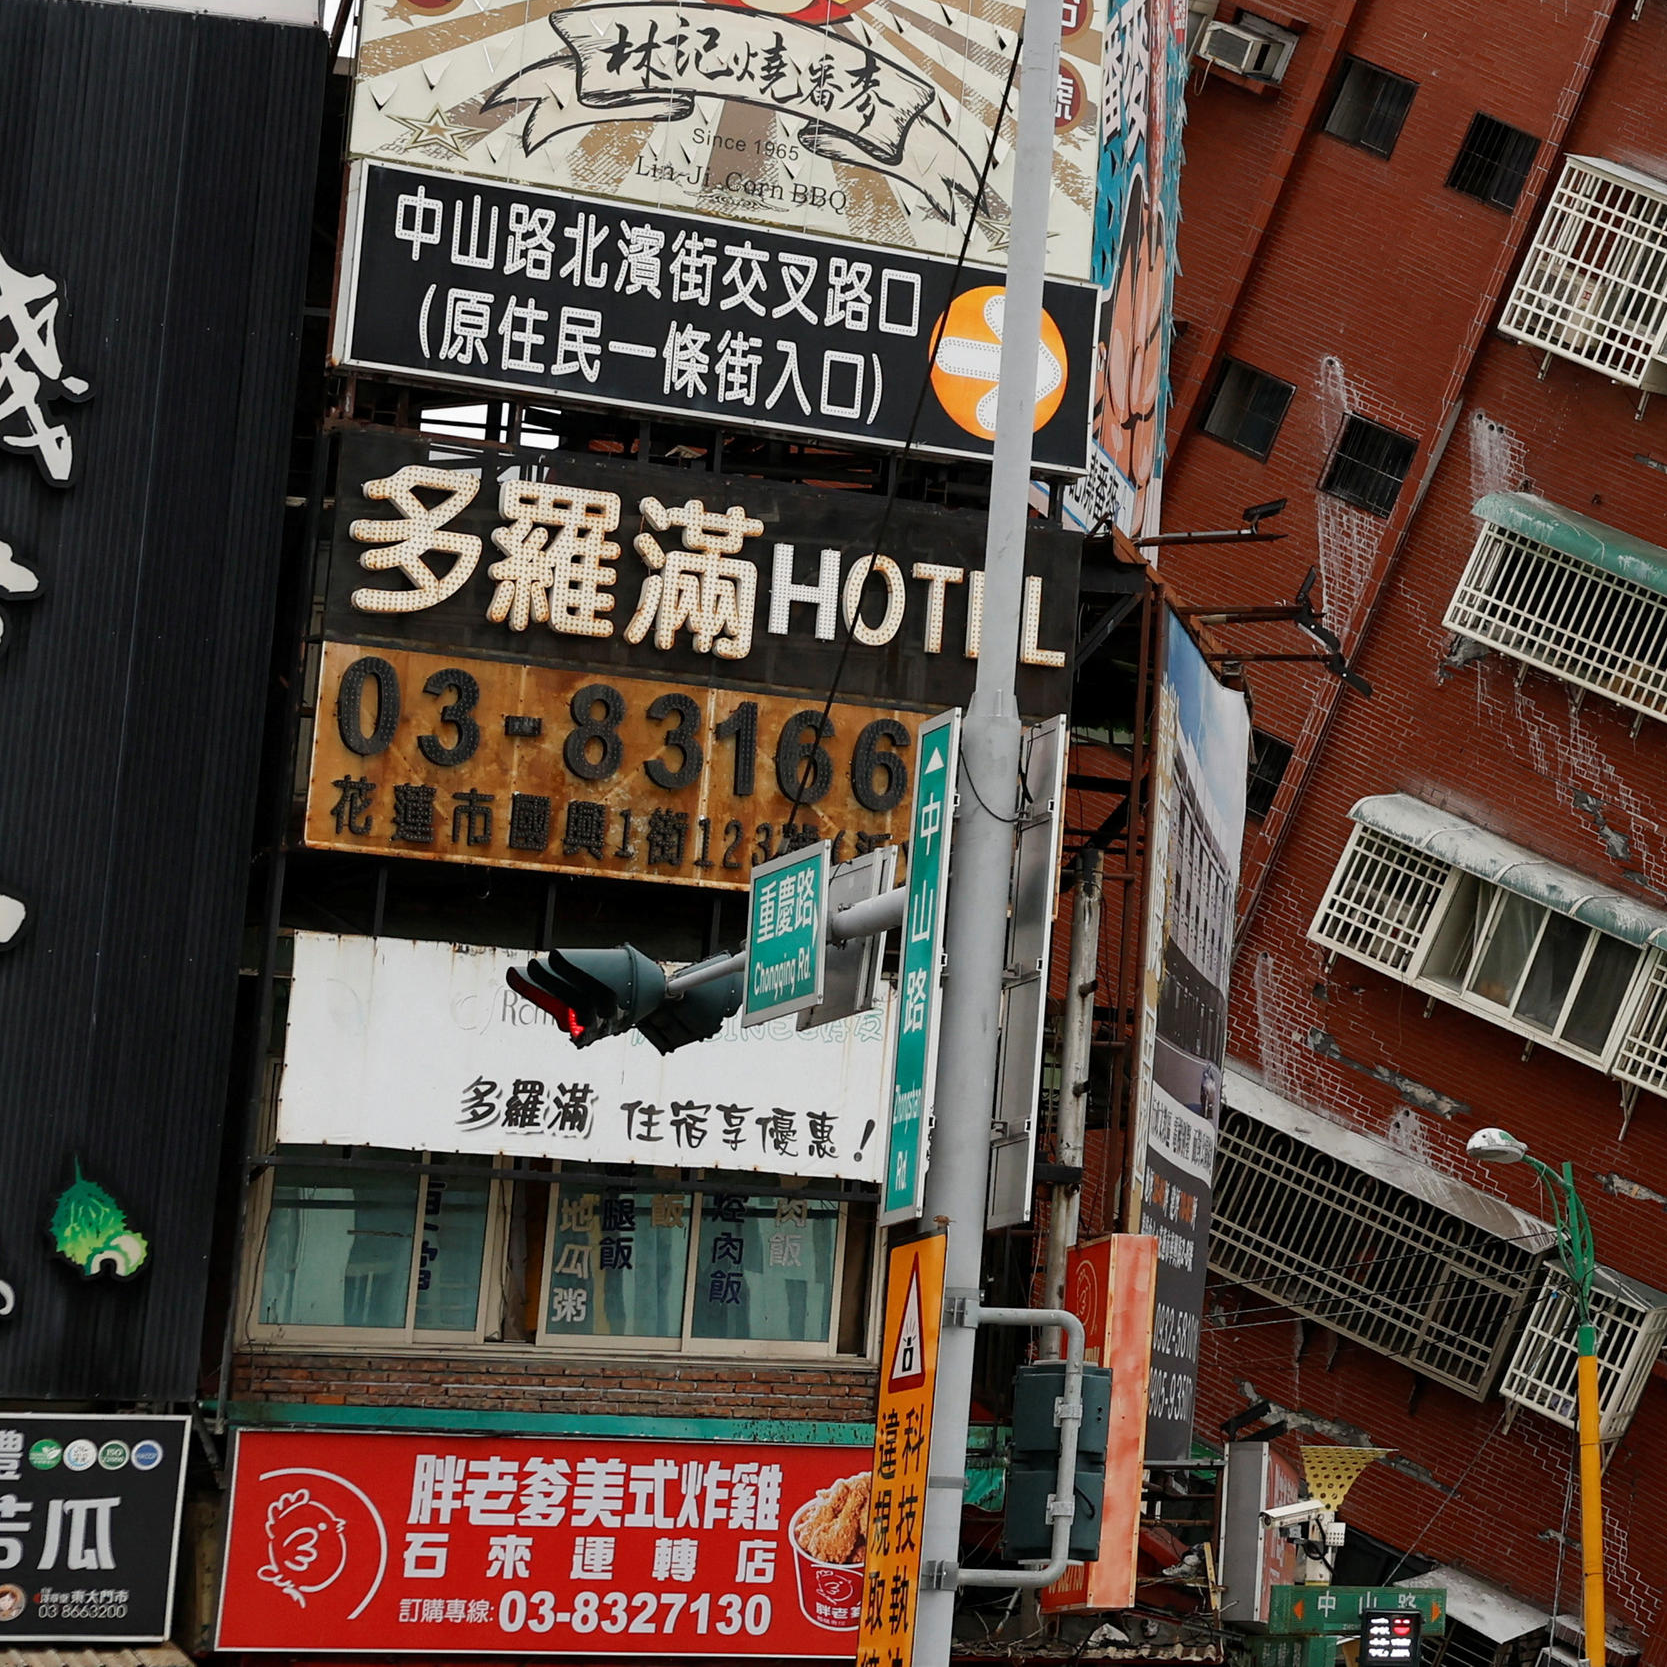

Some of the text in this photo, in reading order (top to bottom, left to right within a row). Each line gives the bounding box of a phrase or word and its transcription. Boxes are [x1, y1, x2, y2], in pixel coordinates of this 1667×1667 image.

[692, 127, 800, 162] Since 1965
[636, 155, 847, 216] Lin-Ji Corn BBQ
[395, 185, 923, 337] 中山路北濱街交叉路口
[418, 282, 883, 426] (原住民一條街入口)
[349, 464, 764, 661] 多羅滿
[337, 655, 912, 814] 03-83166
[756, 867, 816, 944] 重慶路
[903, 791, 942, 1034] 中山路
[753, 952, 797, 1001] Chongqing
[455, 1074, 600, 1139] 多羅滿
[551, 1194, 597, 1324] 地瓜粥
[406, 1453, 783, 1532] 胖老爹美式炸雞
[38, 1604, 128, 1619] 03 8663200
[498, 1589, 772, 1636] 03-8327130
